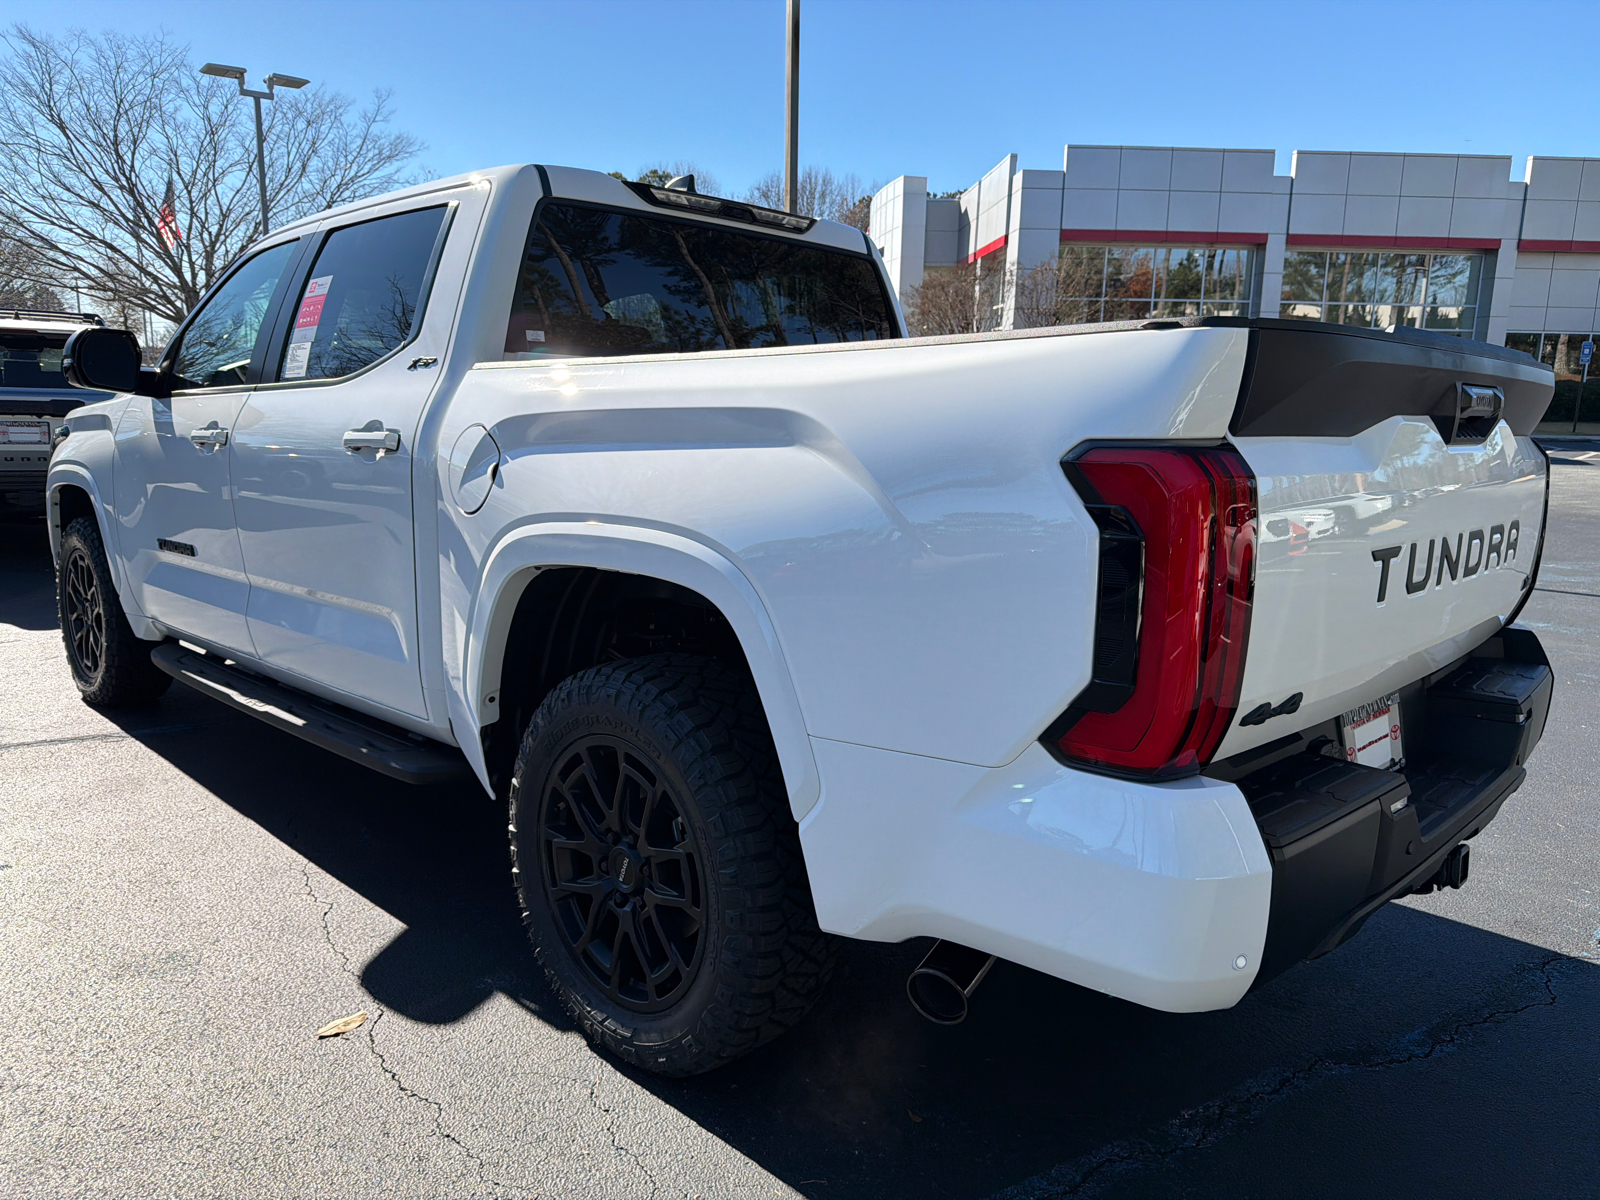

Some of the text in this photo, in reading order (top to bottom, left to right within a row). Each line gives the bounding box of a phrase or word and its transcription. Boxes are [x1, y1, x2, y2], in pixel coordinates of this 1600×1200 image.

[157, 538, 195, 557] TUNDRA
[1371, 519, 1519, 603] TUNDRA
[618, 857, 629, 882] TOYOTA
